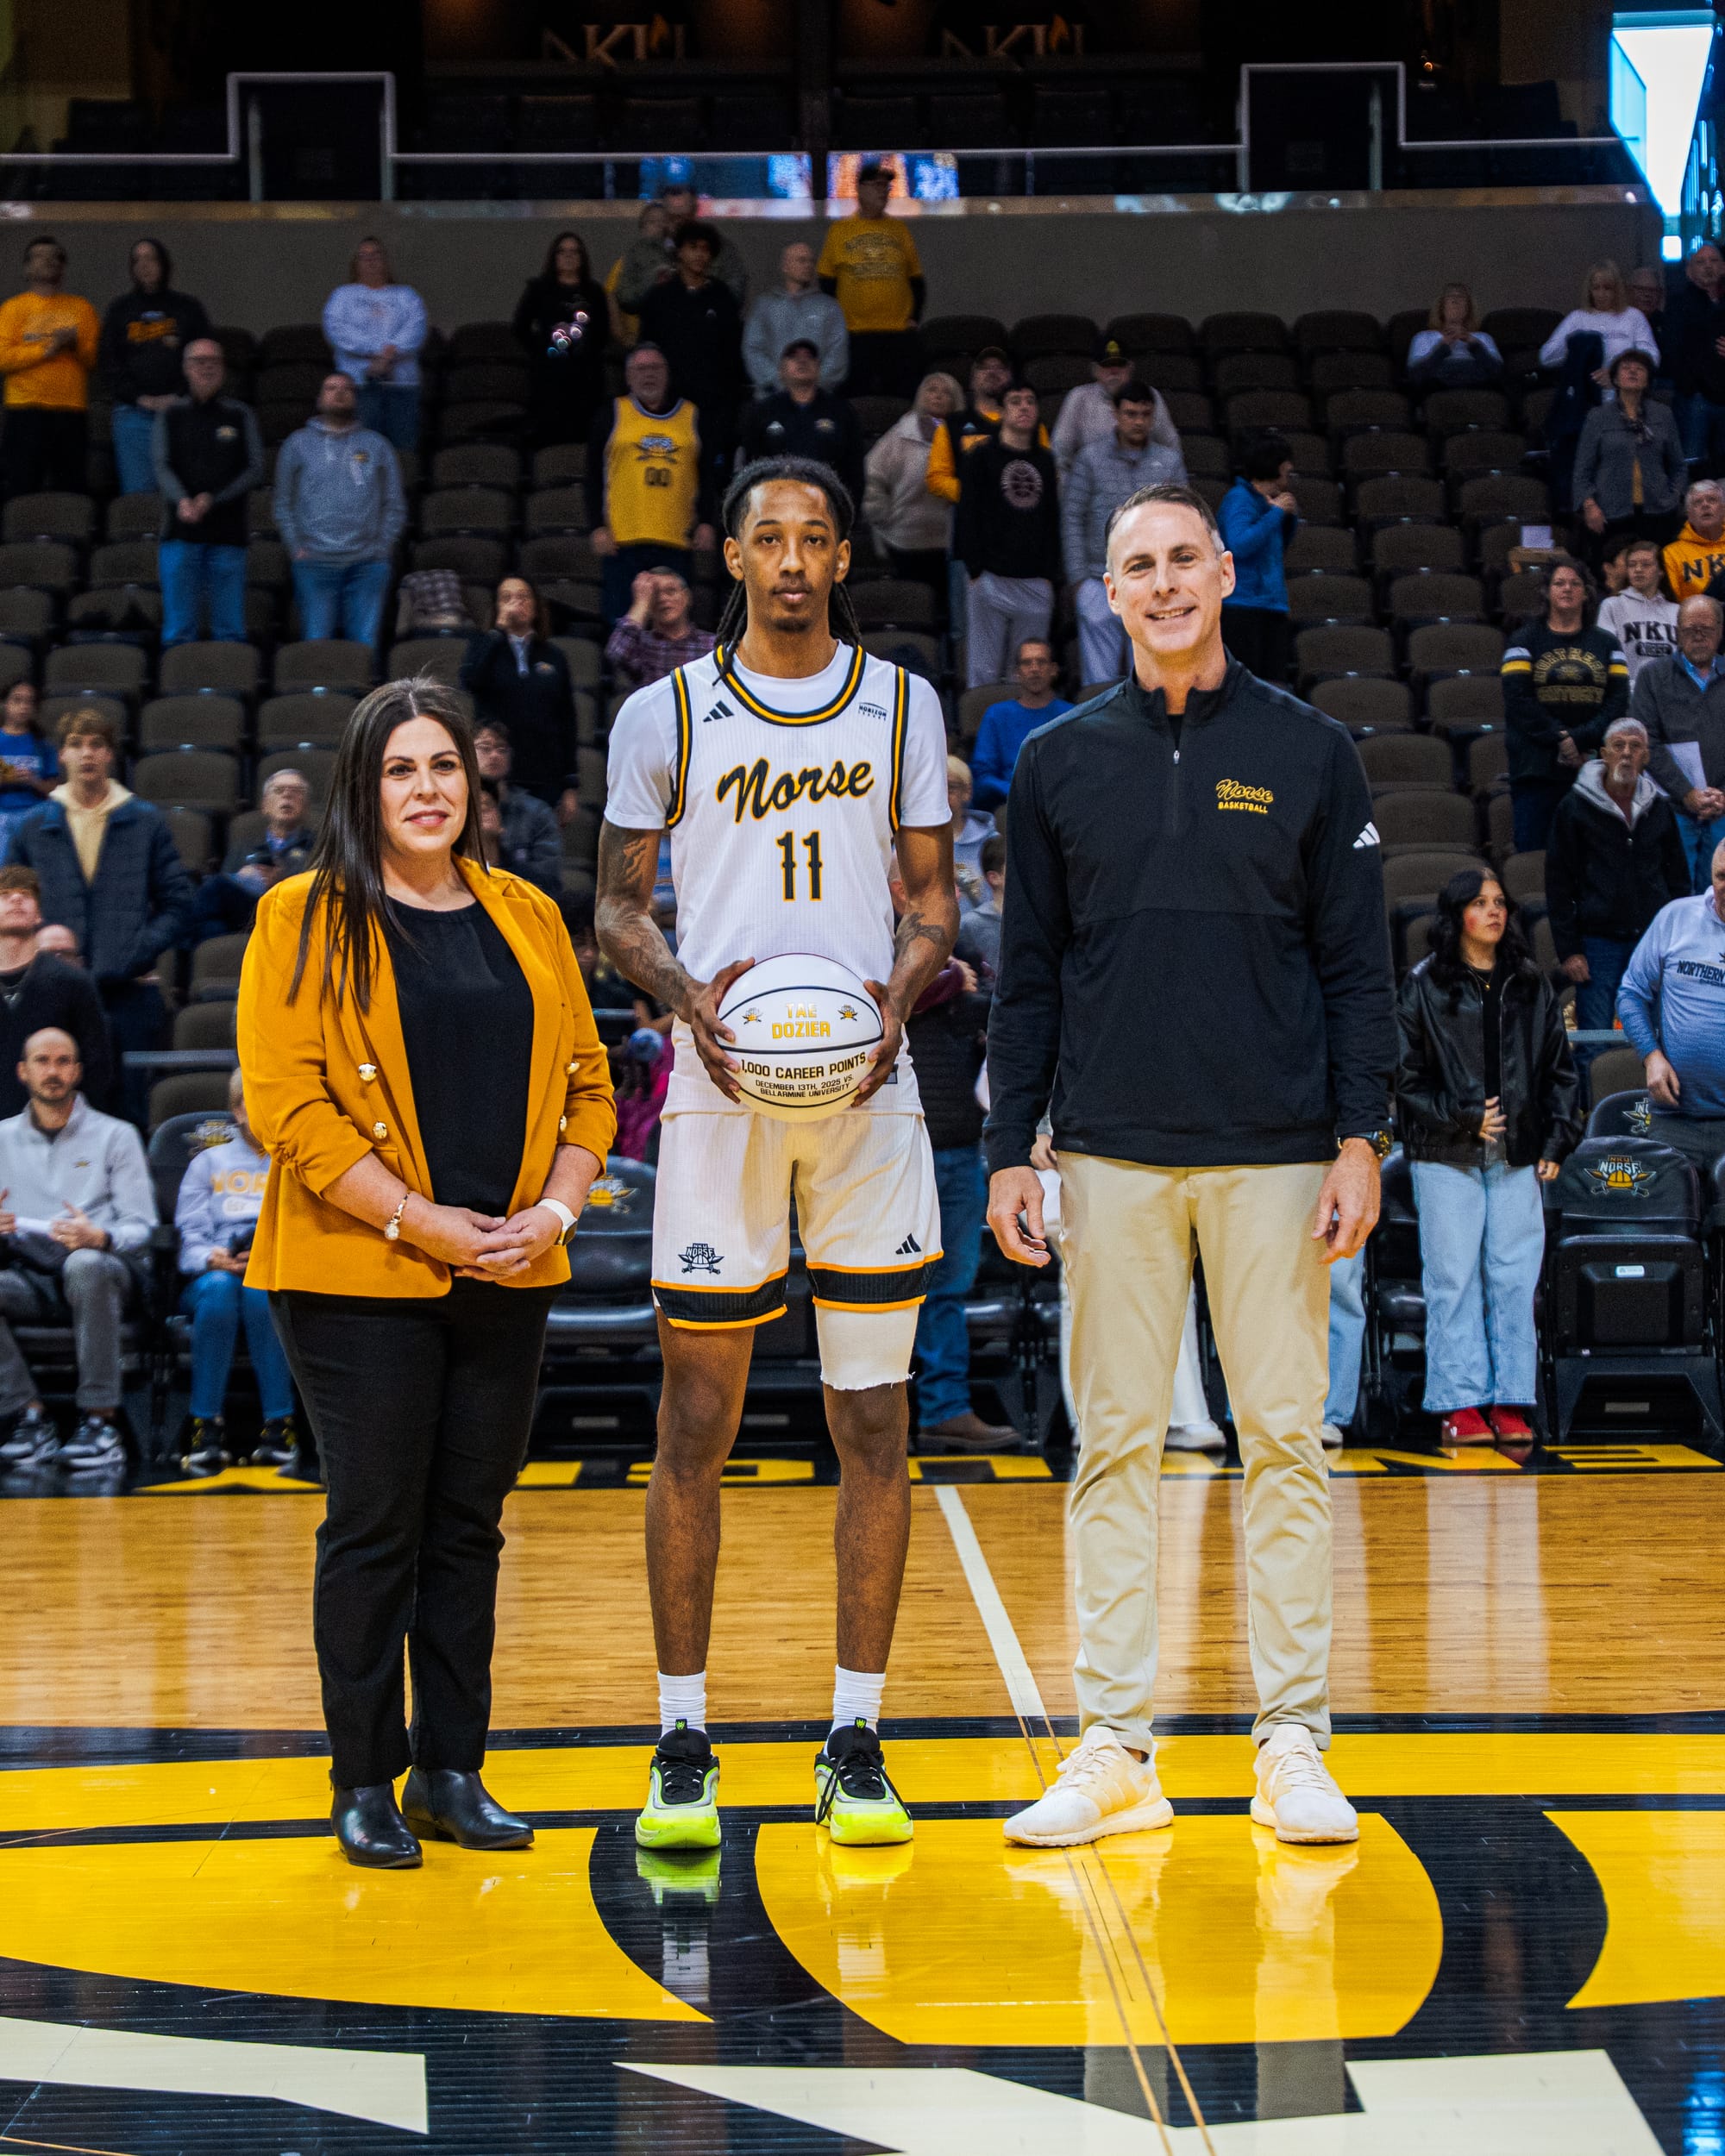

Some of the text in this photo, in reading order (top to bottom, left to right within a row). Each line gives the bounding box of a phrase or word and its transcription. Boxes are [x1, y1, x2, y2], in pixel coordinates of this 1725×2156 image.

[1623, 620, 1678, 644] NKU
[858, 705, 887, 718] HORIZON
[716, 756, 875, 824] Norse
[1215, 778, 1274, 803] Norse
[1218, 802, 1268, 814] BASKETBALL
[776, 830, 824, 901] 11
[786, 1002, 818, 1019] TAE
[771, 1020, 831, 1039] DOZIER
[741, 1050, 866, 1080] 1,000 CAREER POINTS
[755, 1079, 795, 1091] DECEMBER
[820, 1078, 841, 1089] 2025
[760, 1082, 850, 1098] BELLARMINE UNIVERSITY
